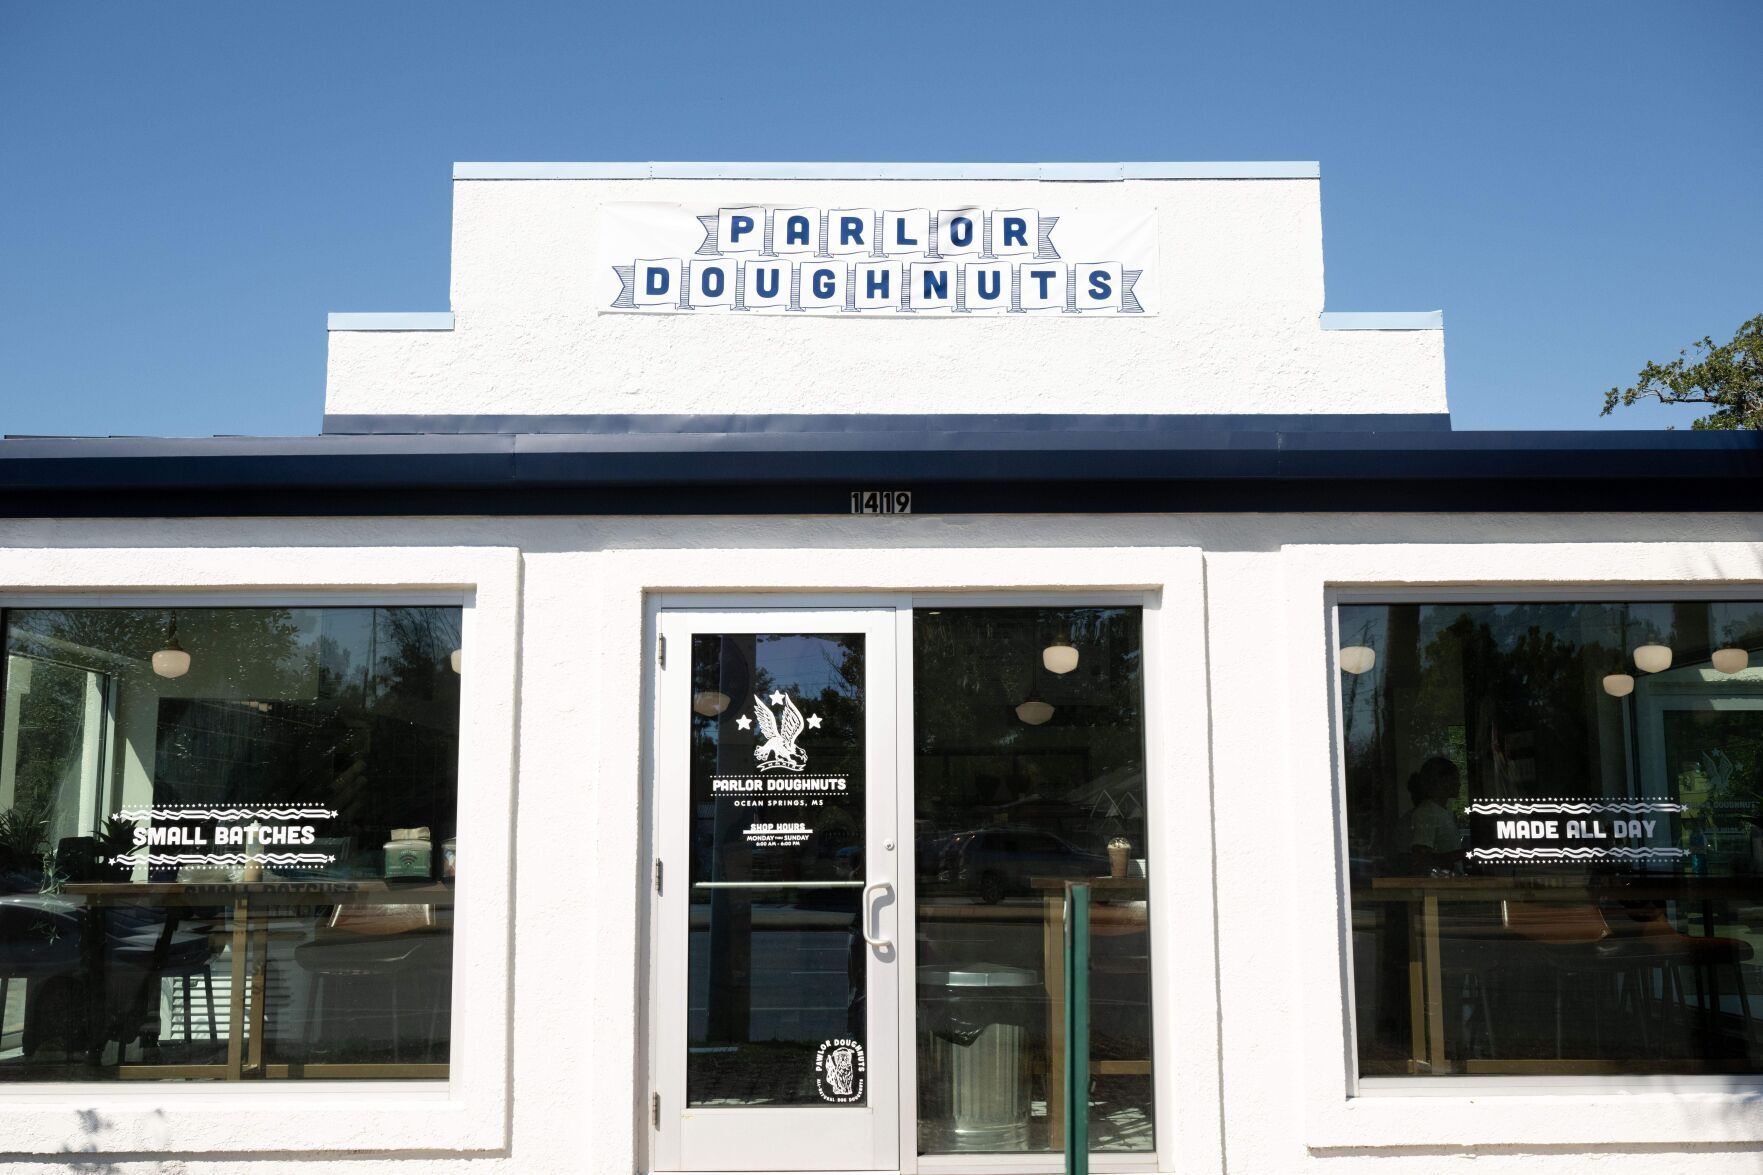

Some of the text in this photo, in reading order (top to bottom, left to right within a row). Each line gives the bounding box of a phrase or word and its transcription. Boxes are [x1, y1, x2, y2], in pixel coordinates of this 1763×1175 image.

[730, 215, 1029, 248] PARLOR
[645, 266, 1112, 302] DOUGHNUTS
[851, 491, 912, 513] 1419
[712, 778, 847, 792] PARLOR DOUGHNUTS
[768, 799, 808, 807] SPRINGS,
[811, 799, 824, 807] MS
[132, 825, 315, 848] SMALL BATCHES
[750, 823, 806, 831] SHOP HOURS
[1497, 820, 1657, 839] MADE ALL DAY
[815, 1039, 865, 1072] PAWLOR DOUGHNUTS
